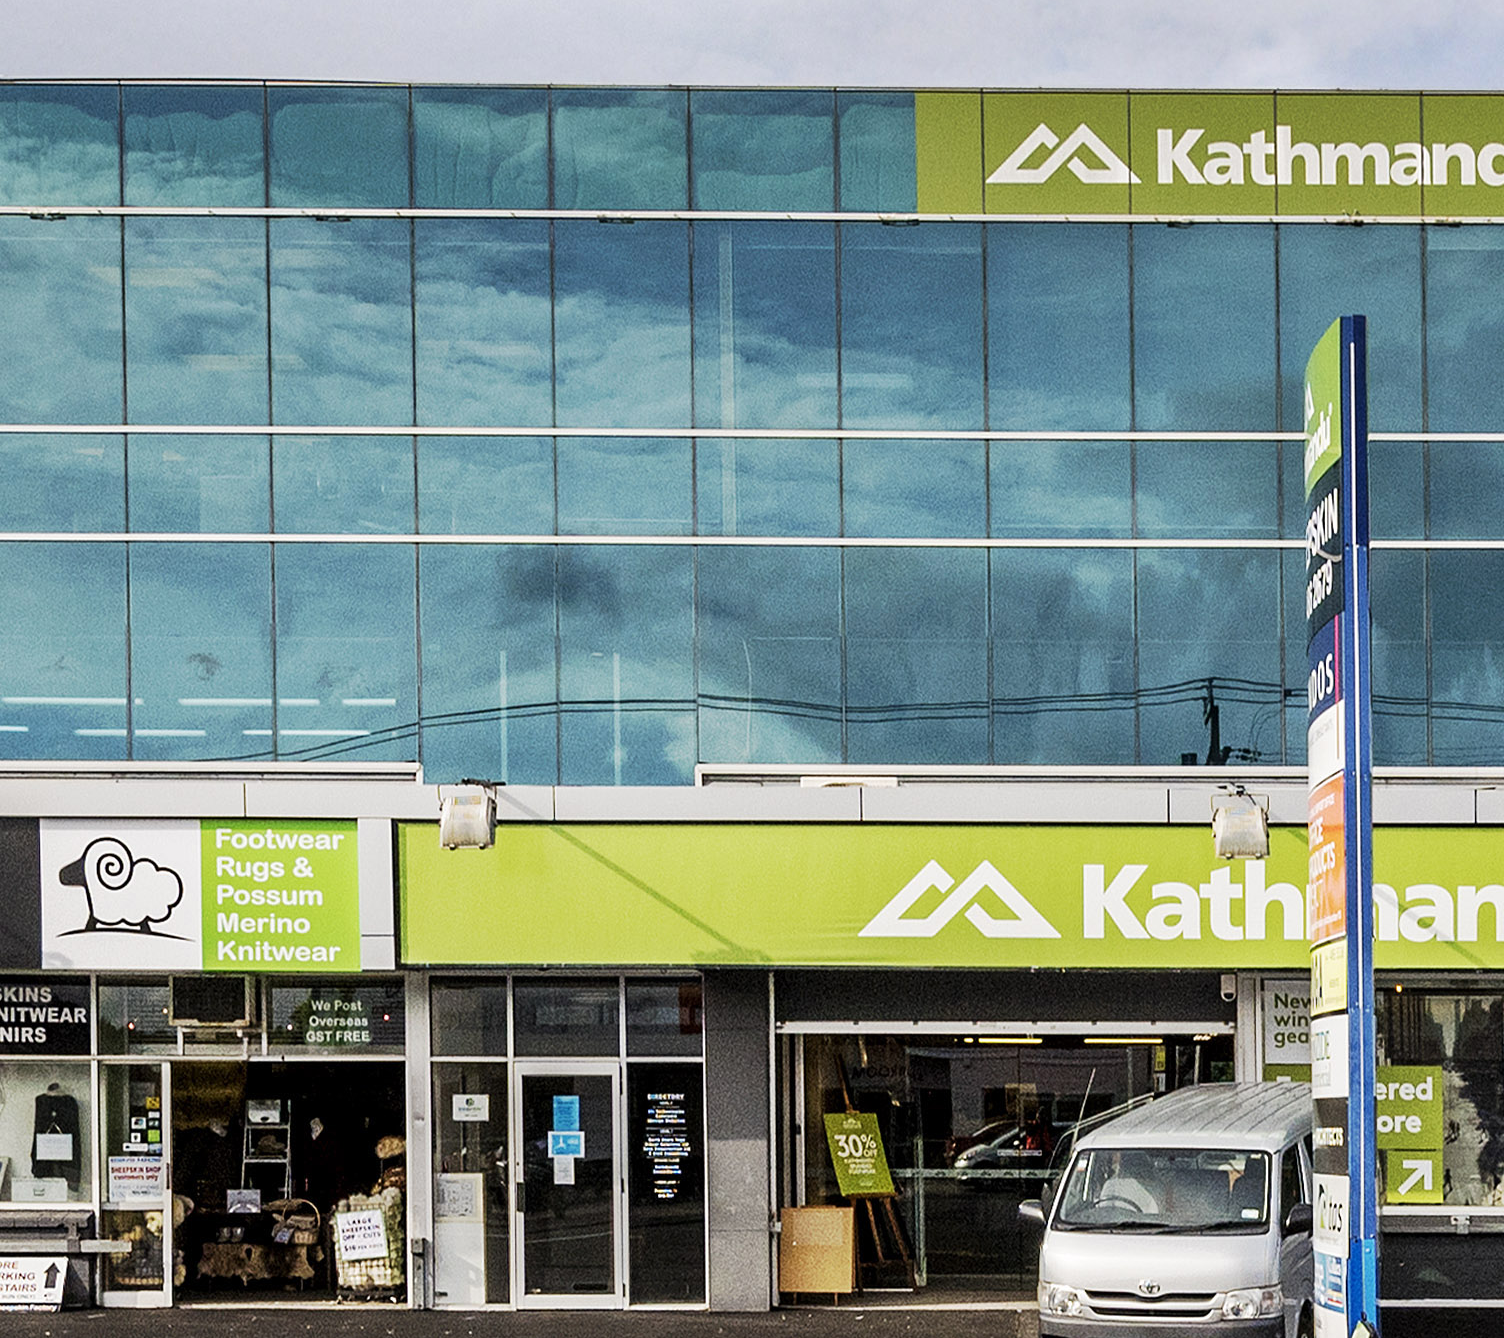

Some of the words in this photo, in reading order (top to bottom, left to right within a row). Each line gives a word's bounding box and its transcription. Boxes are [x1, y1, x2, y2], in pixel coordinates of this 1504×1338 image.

[215, 827, 345, 850] Footwear
[216, 856, 285, 882] Rugs
[292, 857, 314, 878] &
[217, 884, 324, 907] Possum
[217, 912, 311, 934] Merino
[217, 940, 341, 962] Knitwear
[311, 1000, 331, 1011] We
[334, 1000, 363, 1011] Post
[309, 1016, 369, 1027] Overseas
[306, 1030, 332, 1042] GST
[335, 1030, 371, 1042] FREE
[834, 1134, 877, 1158] 30%
